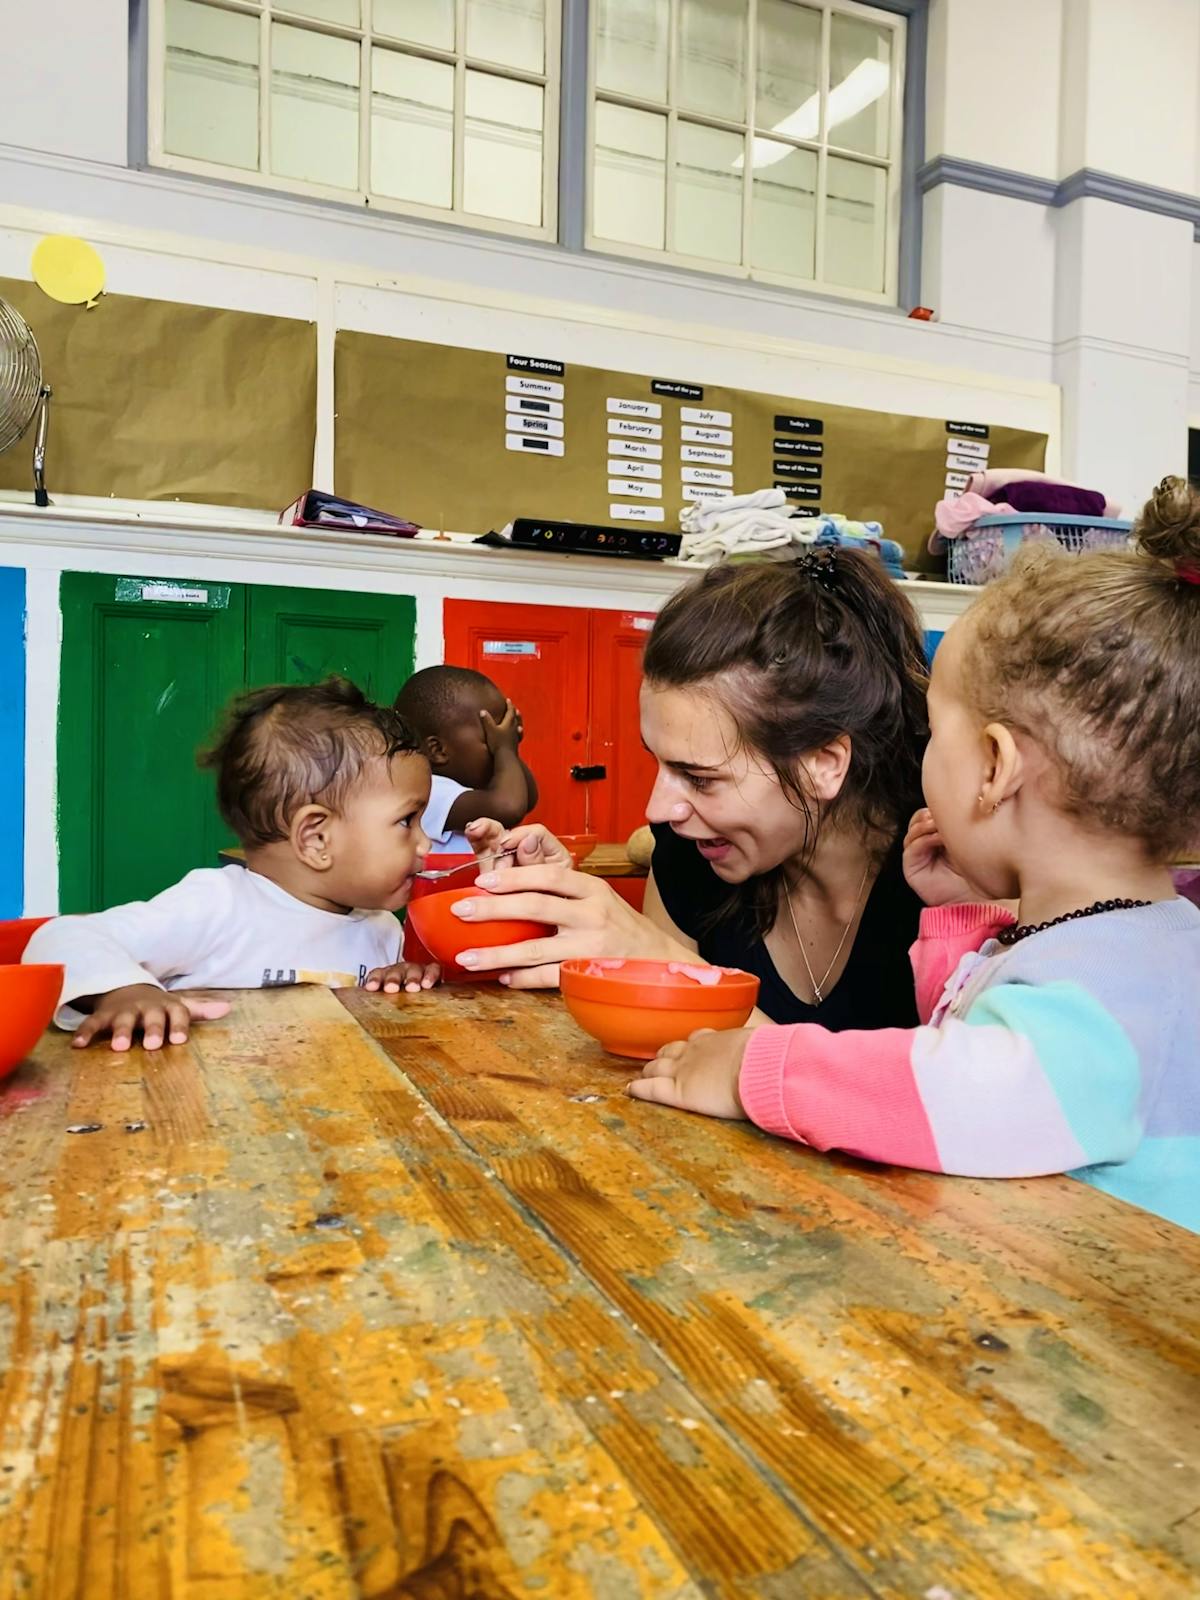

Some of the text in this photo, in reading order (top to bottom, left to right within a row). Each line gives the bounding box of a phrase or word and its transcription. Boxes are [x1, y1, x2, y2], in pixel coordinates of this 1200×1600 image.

[509, 356, 562, 372] Four Seasons
[520, 380, 551, 392] Summer
[618, 402, 648, 414] January
[699, 411, 714, 421] July
[522, 418, 548, 431] Spring
[619, 422, 652, 434] February
[695, 430, 720, 440] August
[624, 443, 647, 454] March
[957, 443, 980, 452] Monday
[688, 449, 725, 459] September
[956, 458, 979, 467] Tuesday
[627, 463, 644, 474] April
[694, 470, 721, 480] October
[627, 483, 643, 494] May
[689, 489, 727, 498] November
[629, 508, 645, 516] June
